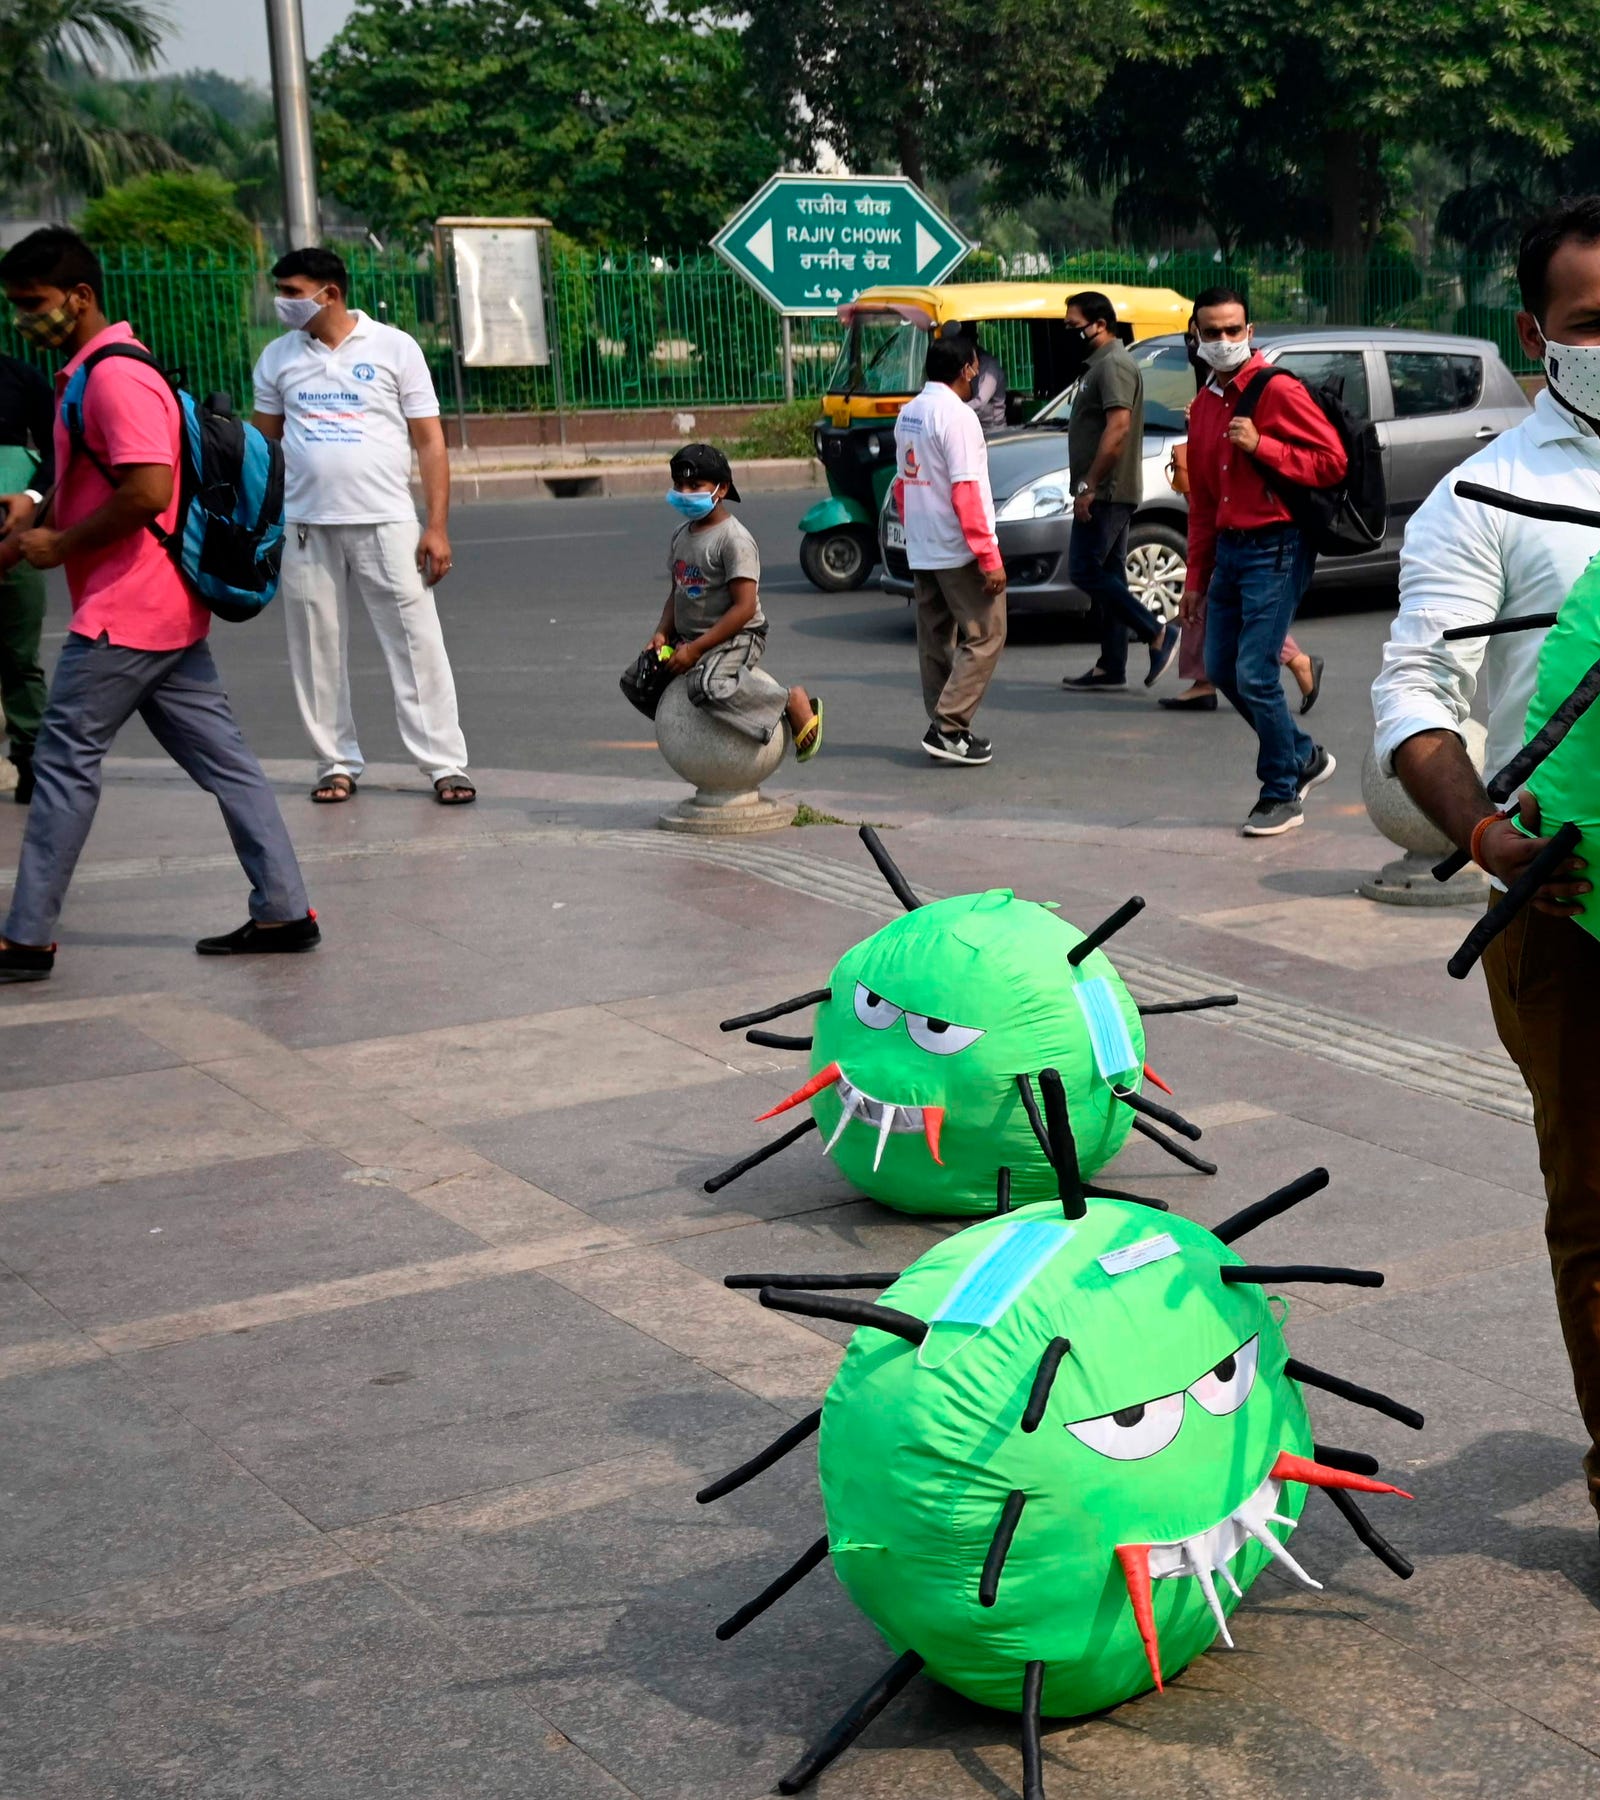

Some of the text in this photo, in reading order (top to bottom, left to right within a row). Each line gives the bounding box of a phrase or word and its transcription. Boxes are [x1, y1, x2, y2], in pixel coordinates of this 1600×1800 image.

[797, 193, 891, 216] राजीव चौक
[787, 226, 902, 244] RAJIV CHOWK
[297, 391, 359, 402] Manoratna
